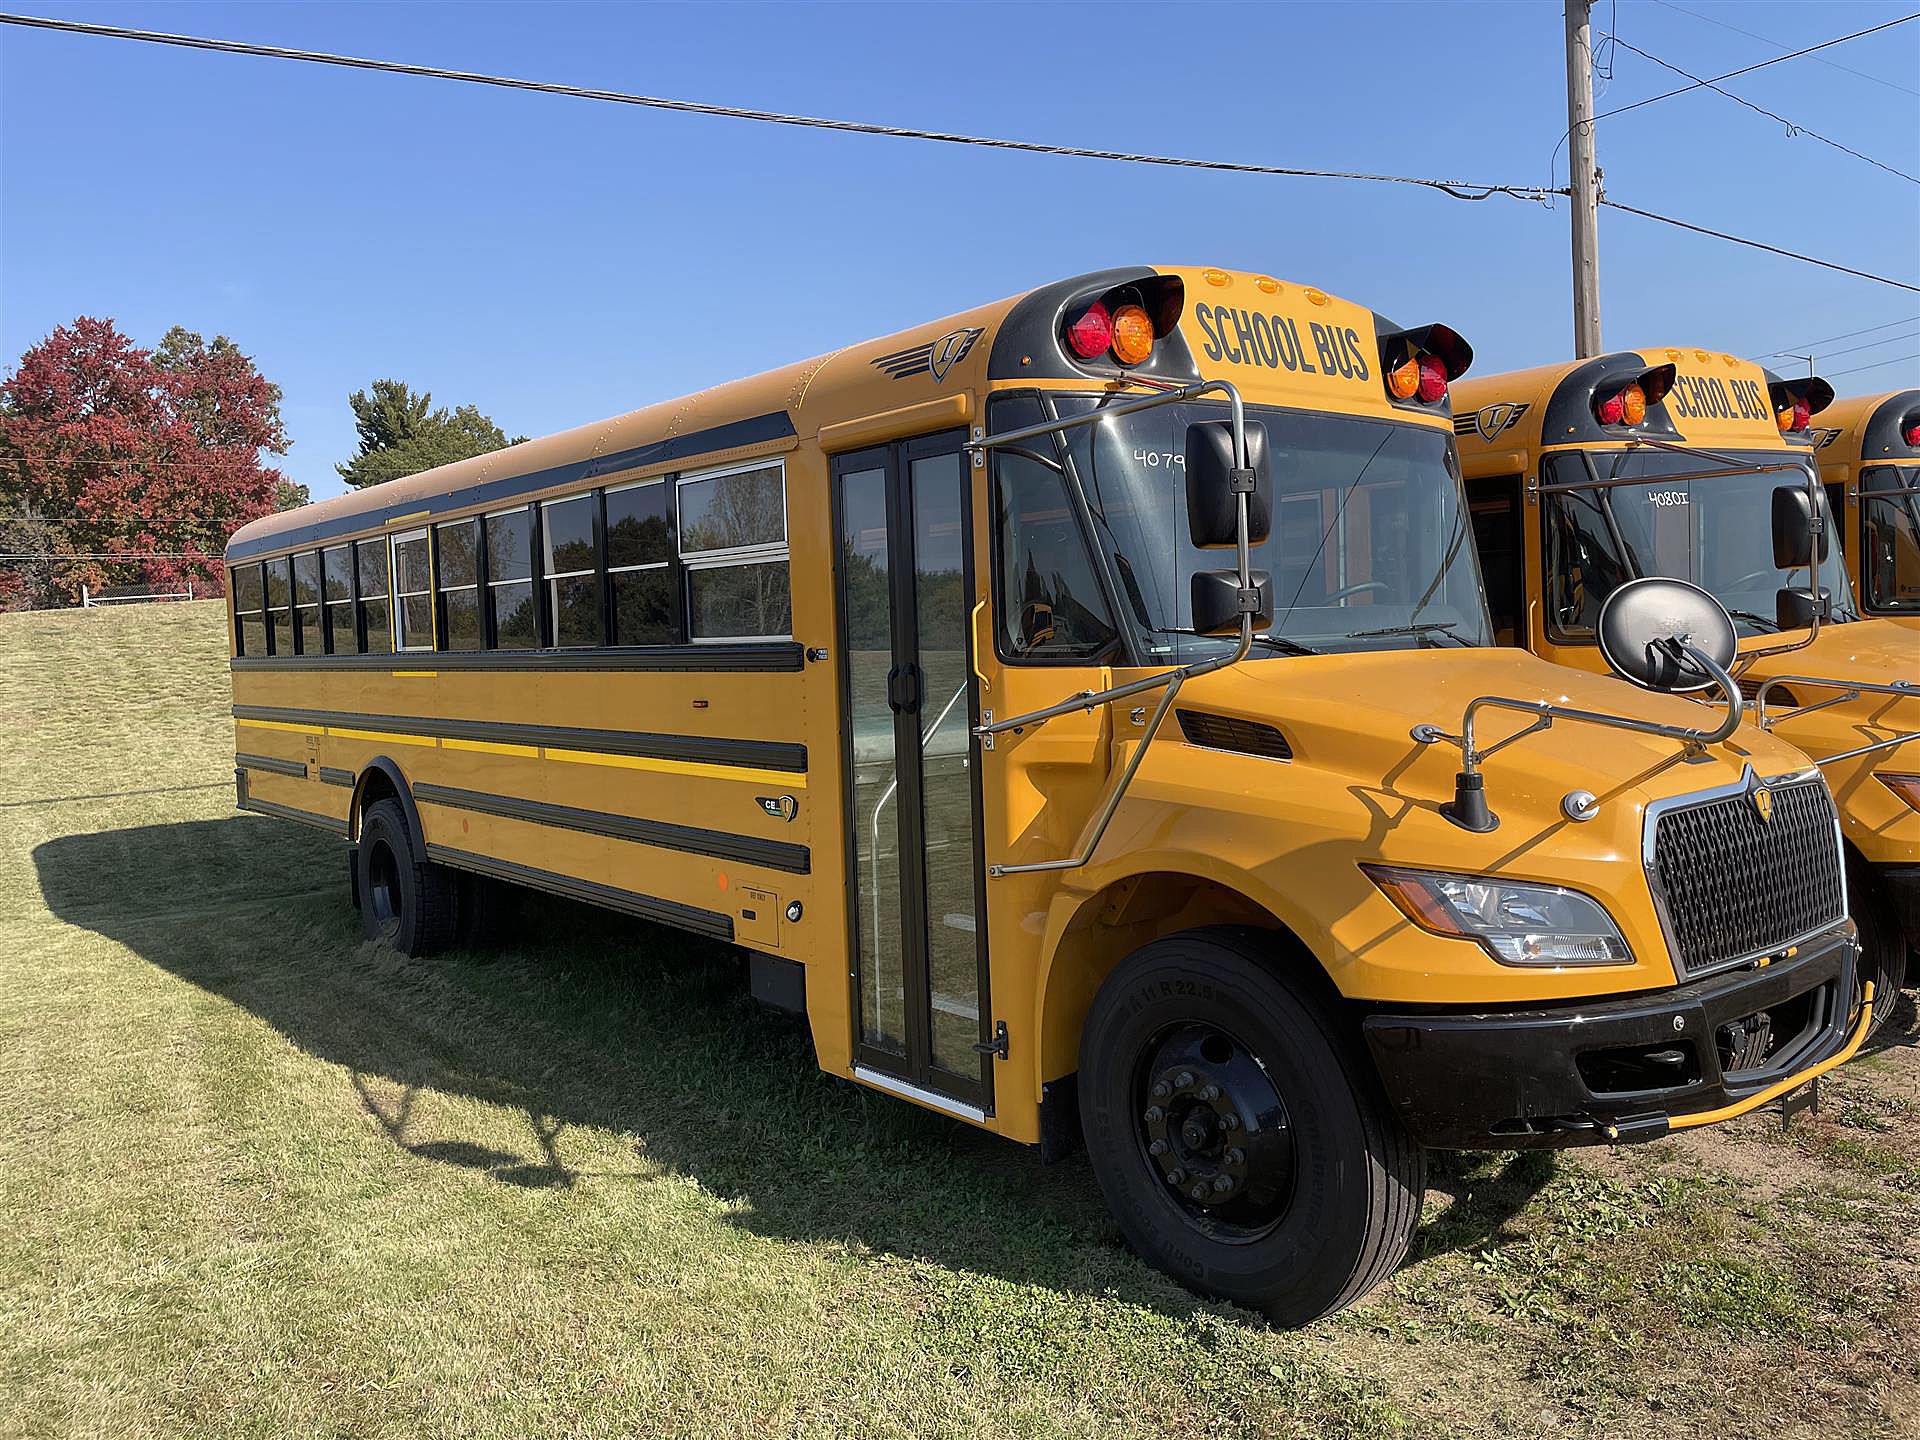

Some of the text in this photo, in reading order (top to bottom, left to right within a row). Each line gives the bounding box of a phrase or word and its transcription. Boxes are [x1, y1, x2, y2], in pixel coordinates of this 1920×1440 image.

[1195, 302, 1370, 382] SCHOOL BUS
[1672, 375, 1769, 421] SCHOOL BUS
[1134, 449, 1187, 473] 4079
[765, 799, 776, 809] CE
